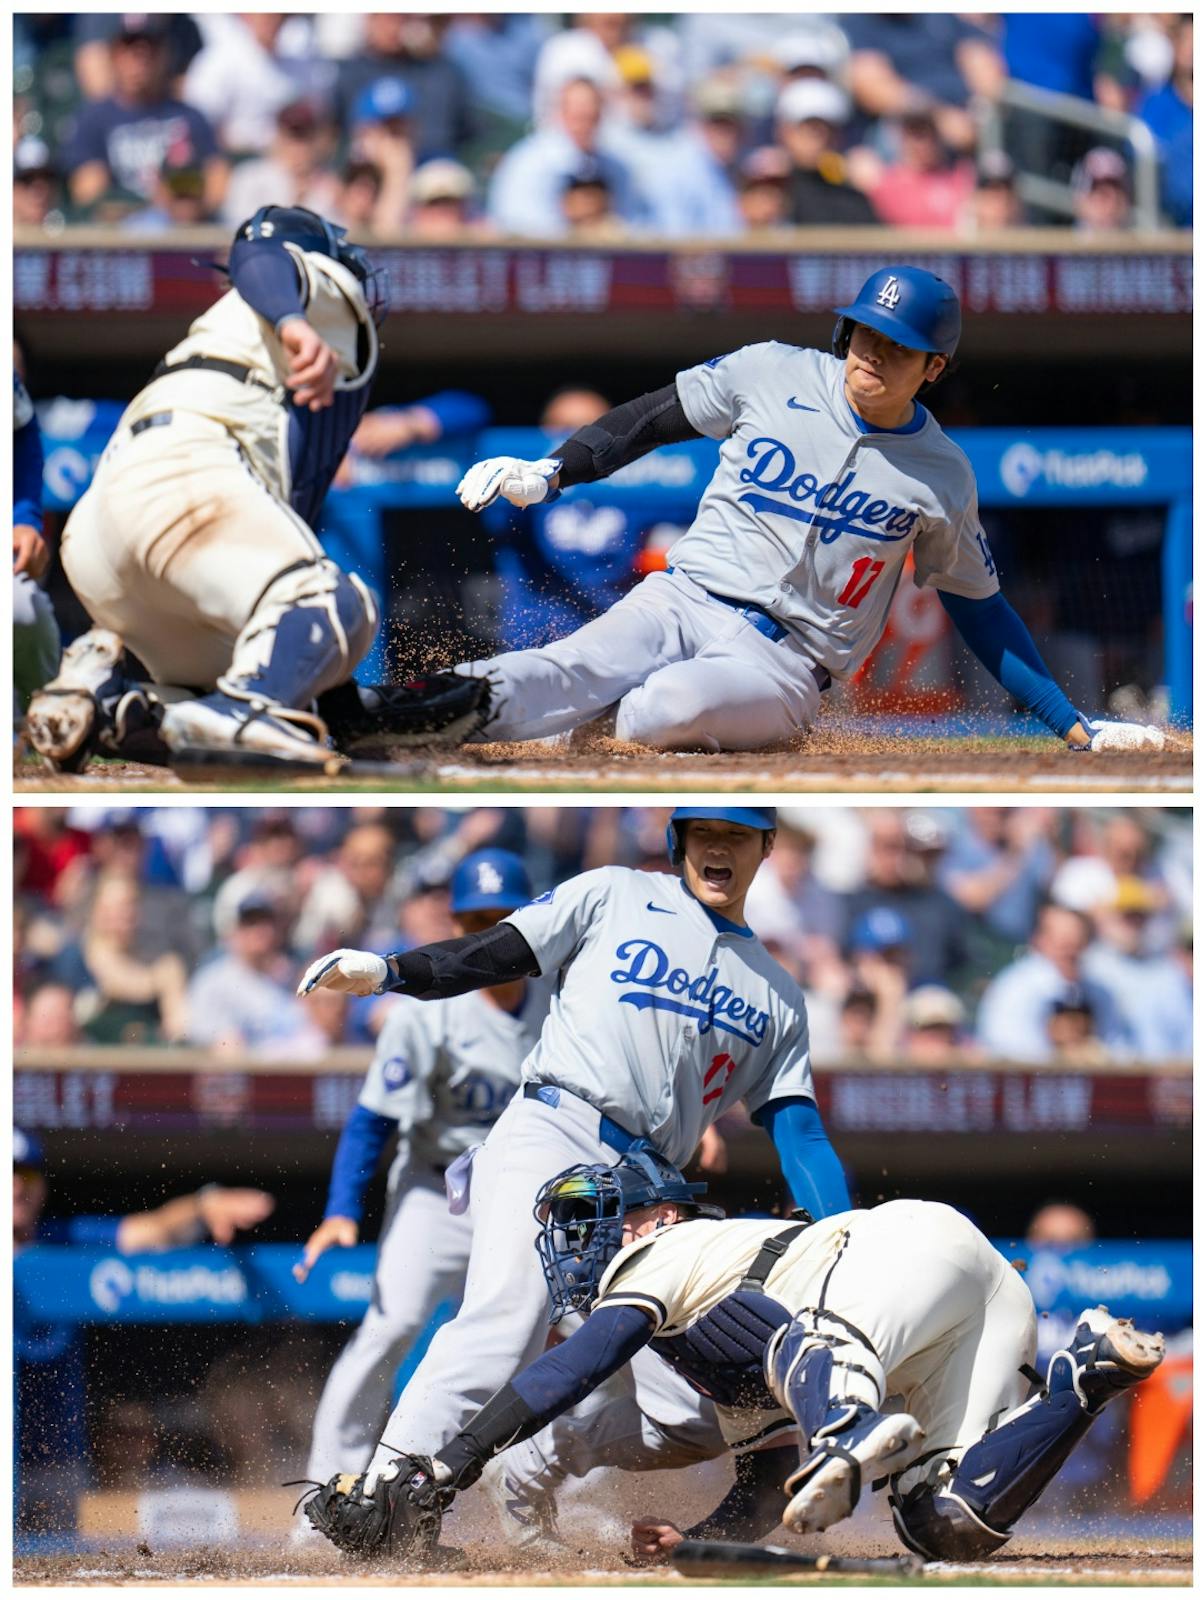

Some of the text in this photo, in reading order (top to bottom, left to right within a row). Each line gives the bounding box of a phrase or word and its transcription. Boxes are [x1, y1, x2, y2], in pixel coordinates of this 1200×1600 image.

[877, 275, 901, 311] LA
[739, 437, 920, 544] Dodgers
[838, 556, 885, 609] 17
[610, 939, 770, 1042] Dodgers
